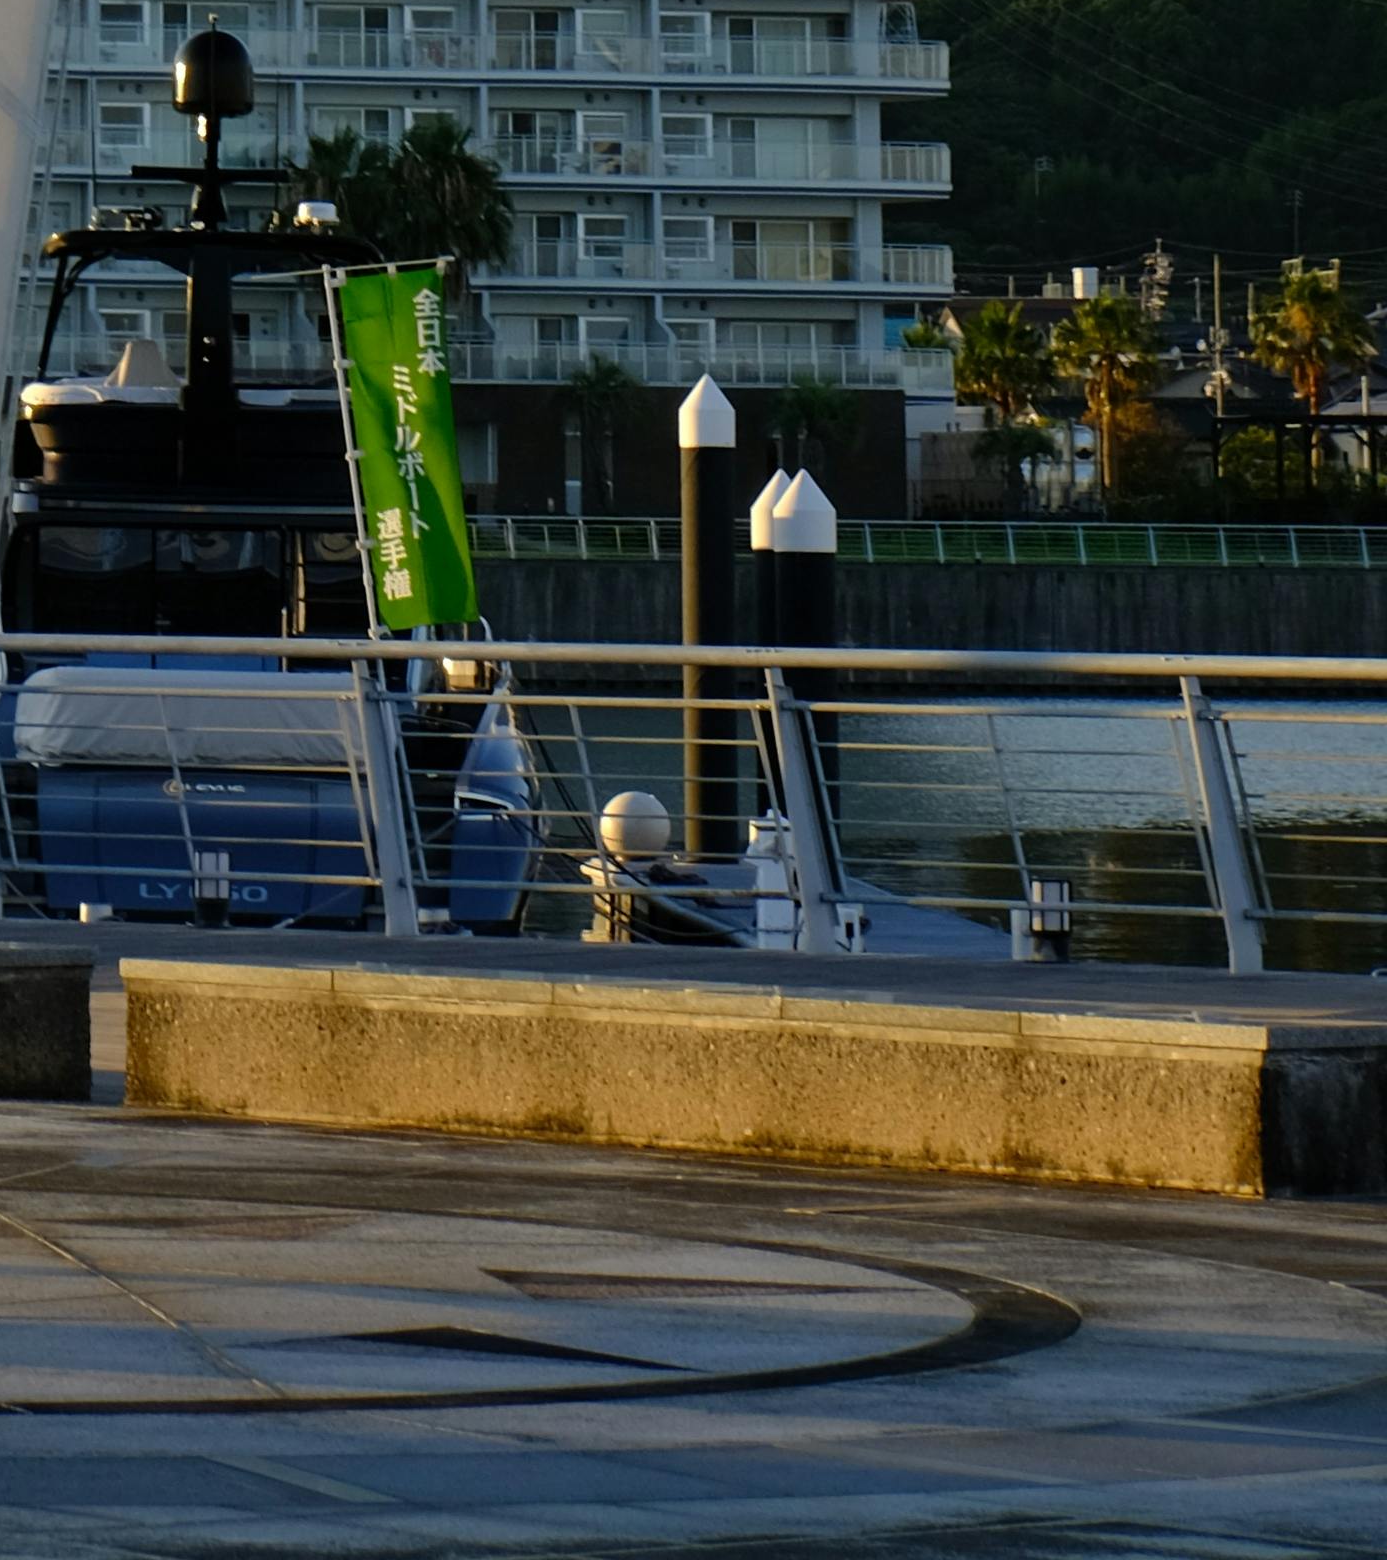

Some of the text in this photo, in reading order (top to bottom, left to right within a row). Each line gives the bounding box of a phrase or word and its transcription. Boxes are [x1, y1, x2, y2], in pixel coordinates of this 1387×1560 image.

[412, 287, 446, 377] 全日本
[392, 365, 430, 539] ミドルボート
[376, 507, 413, 601] 選手権
